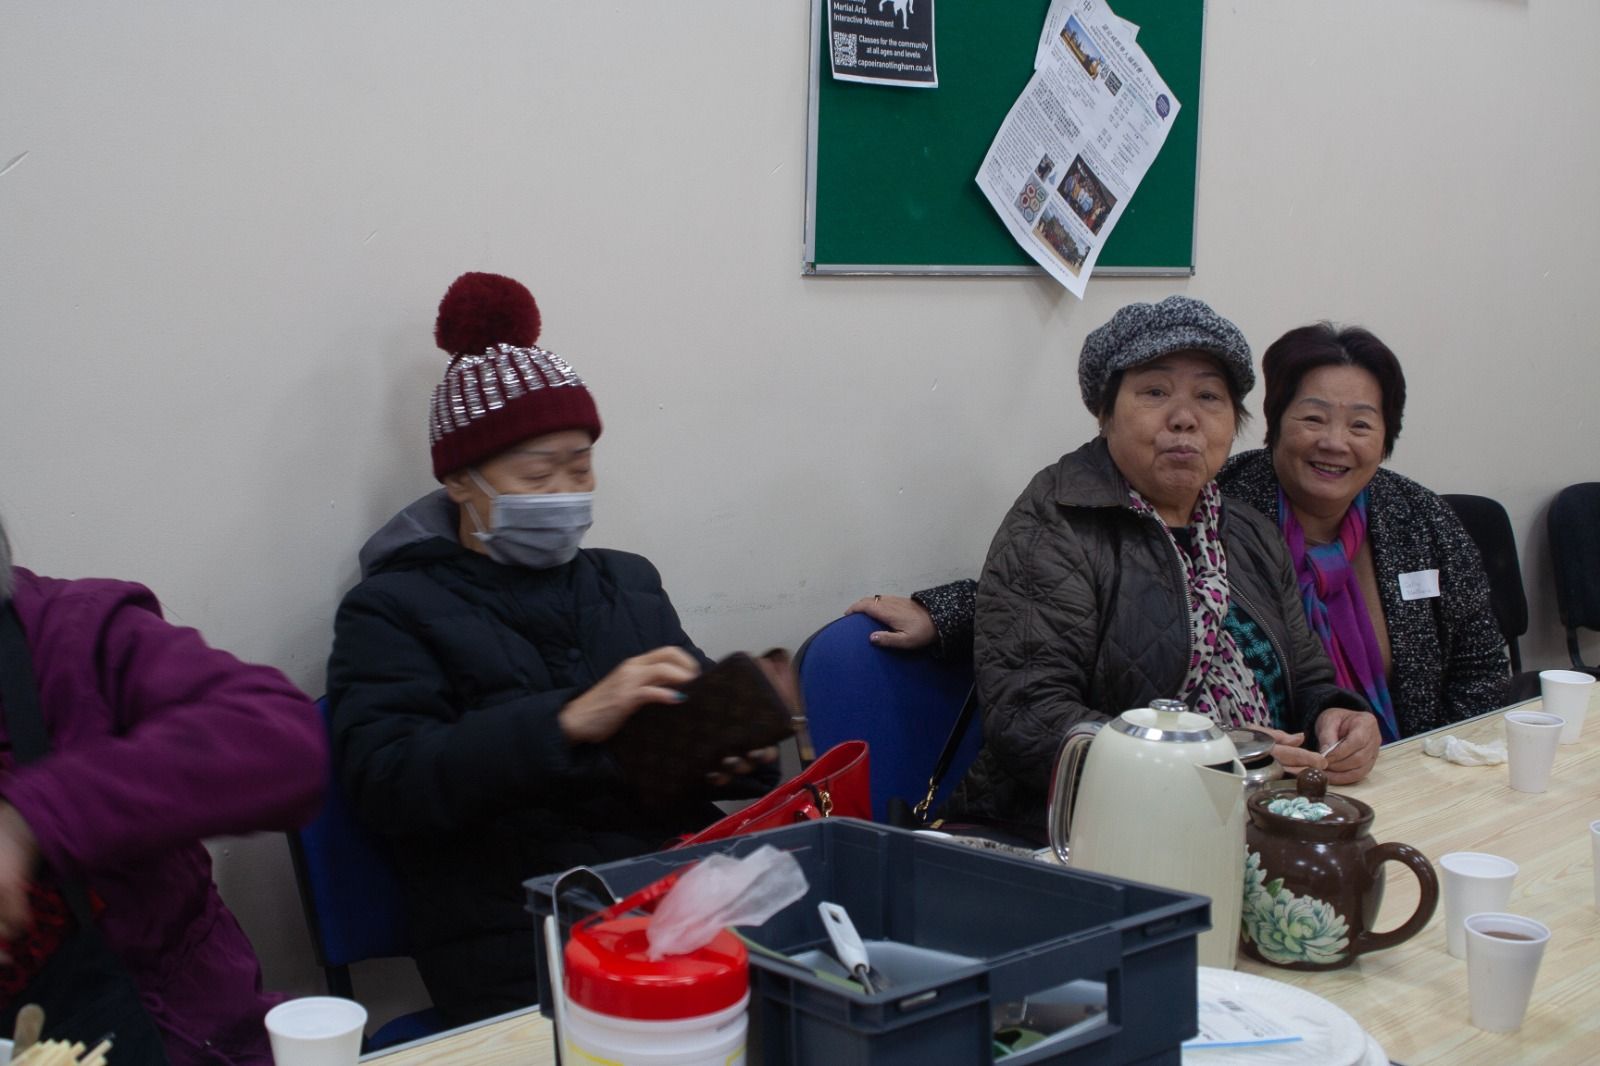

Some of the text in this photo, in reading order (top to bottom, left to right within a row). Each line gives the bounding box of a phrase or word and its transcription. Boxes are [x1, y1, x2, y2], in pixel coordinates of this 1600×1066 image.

[833, 1, 854, 12] Martial
[854, 4, 867, 14] Arts
[833, 13, 894, 28] Interactive Movement
[858, 35, 929, 50] Classes for the community
[872, 47, 880, 55] all
[879, 49, 893, 57] ages
[893, 49, 905, 57] and
[905, 49, 921, 59] levels
[857, 59, 932, 72] capoeiranottingham.co.uk
